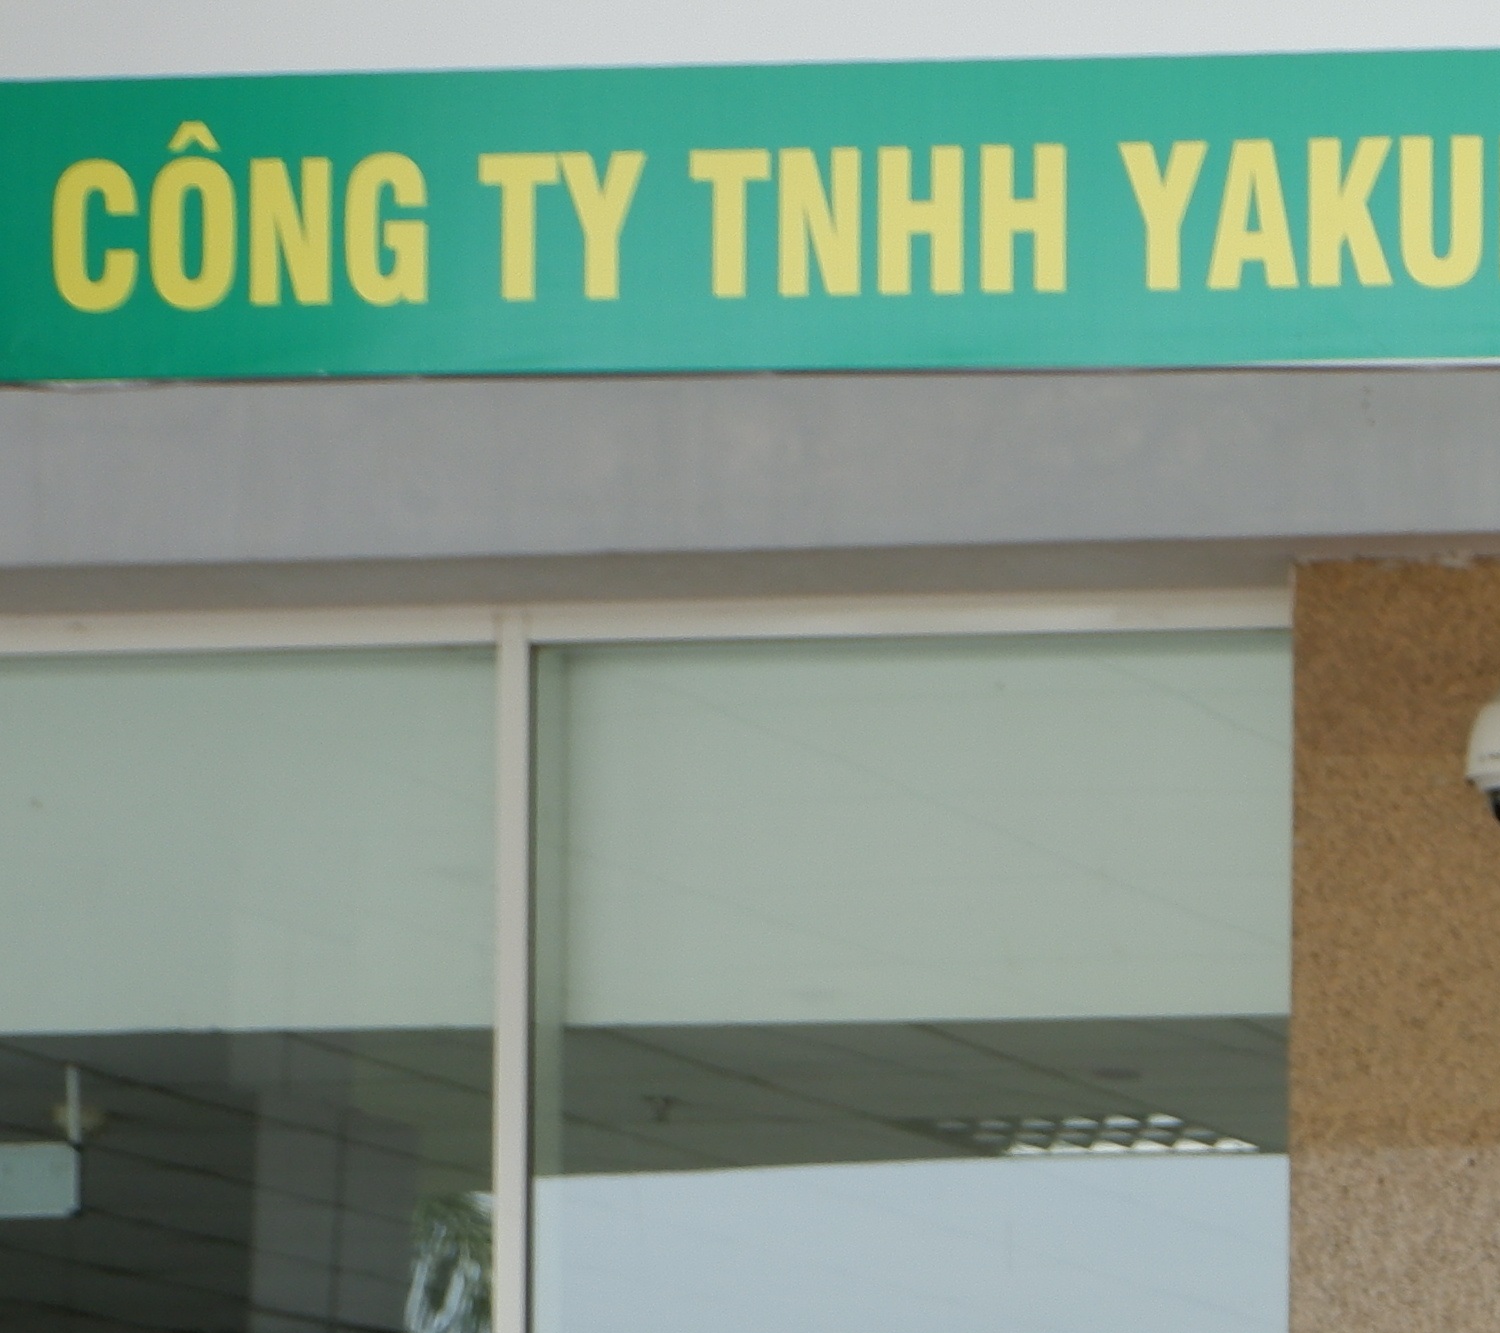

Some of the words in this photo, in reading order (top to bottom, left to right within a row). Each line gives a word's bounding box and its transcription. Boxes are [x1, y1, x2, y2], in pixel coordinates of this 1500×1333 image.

[55, 124, 423, 309] CÔNG
[481, 153, 641, 297] TY
[692, 146, 1063, 294] TNHH
